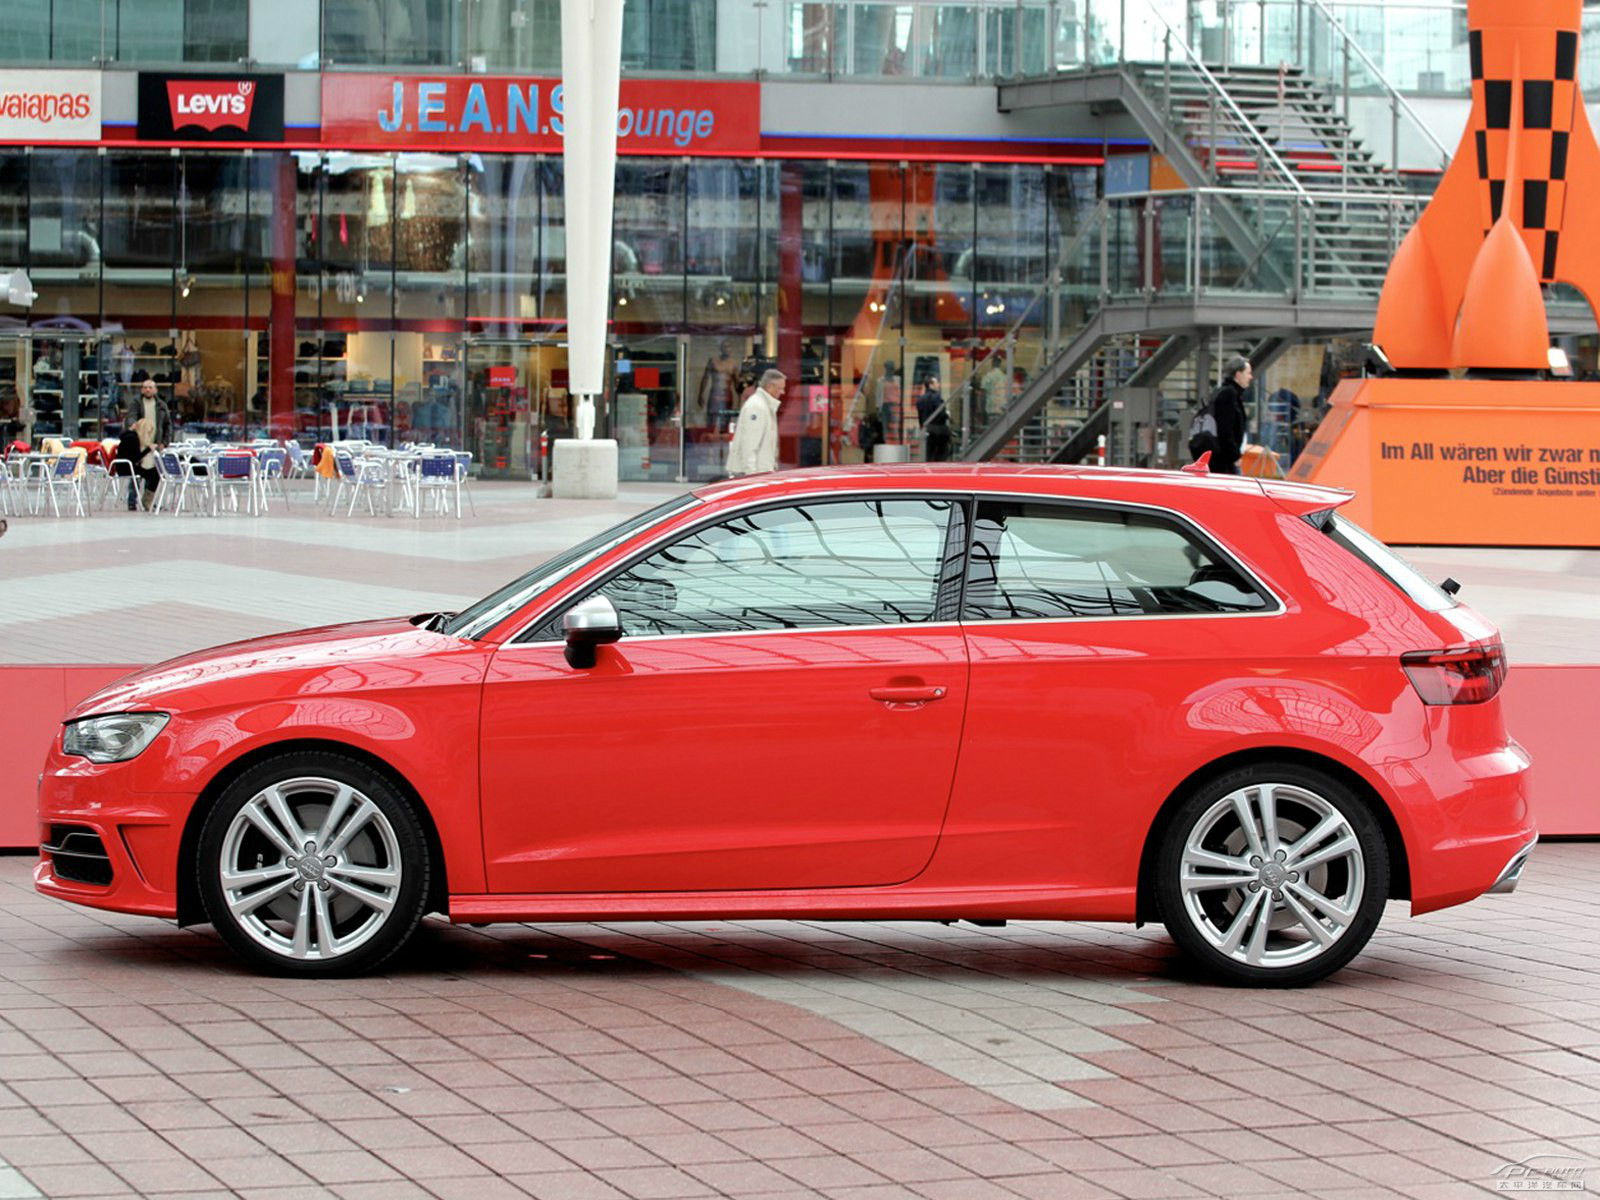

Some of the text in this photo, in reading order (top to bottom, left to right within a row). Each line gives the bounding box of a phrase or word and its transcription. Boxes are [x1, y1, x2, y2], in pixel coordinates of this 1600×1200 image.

[616, 107, 715, 147] ounge
[1381, 441, 1405, 460] Im
[1411, 442, 1435, 461] All
[1440, 443, 1498, 462] wären
[1504, 444, 1533, 462] wir
[1539, 448, 1584, 463] zwar
[1462, 465, 1506, 484] Aber
[1511, 466, 1539, 485] die
